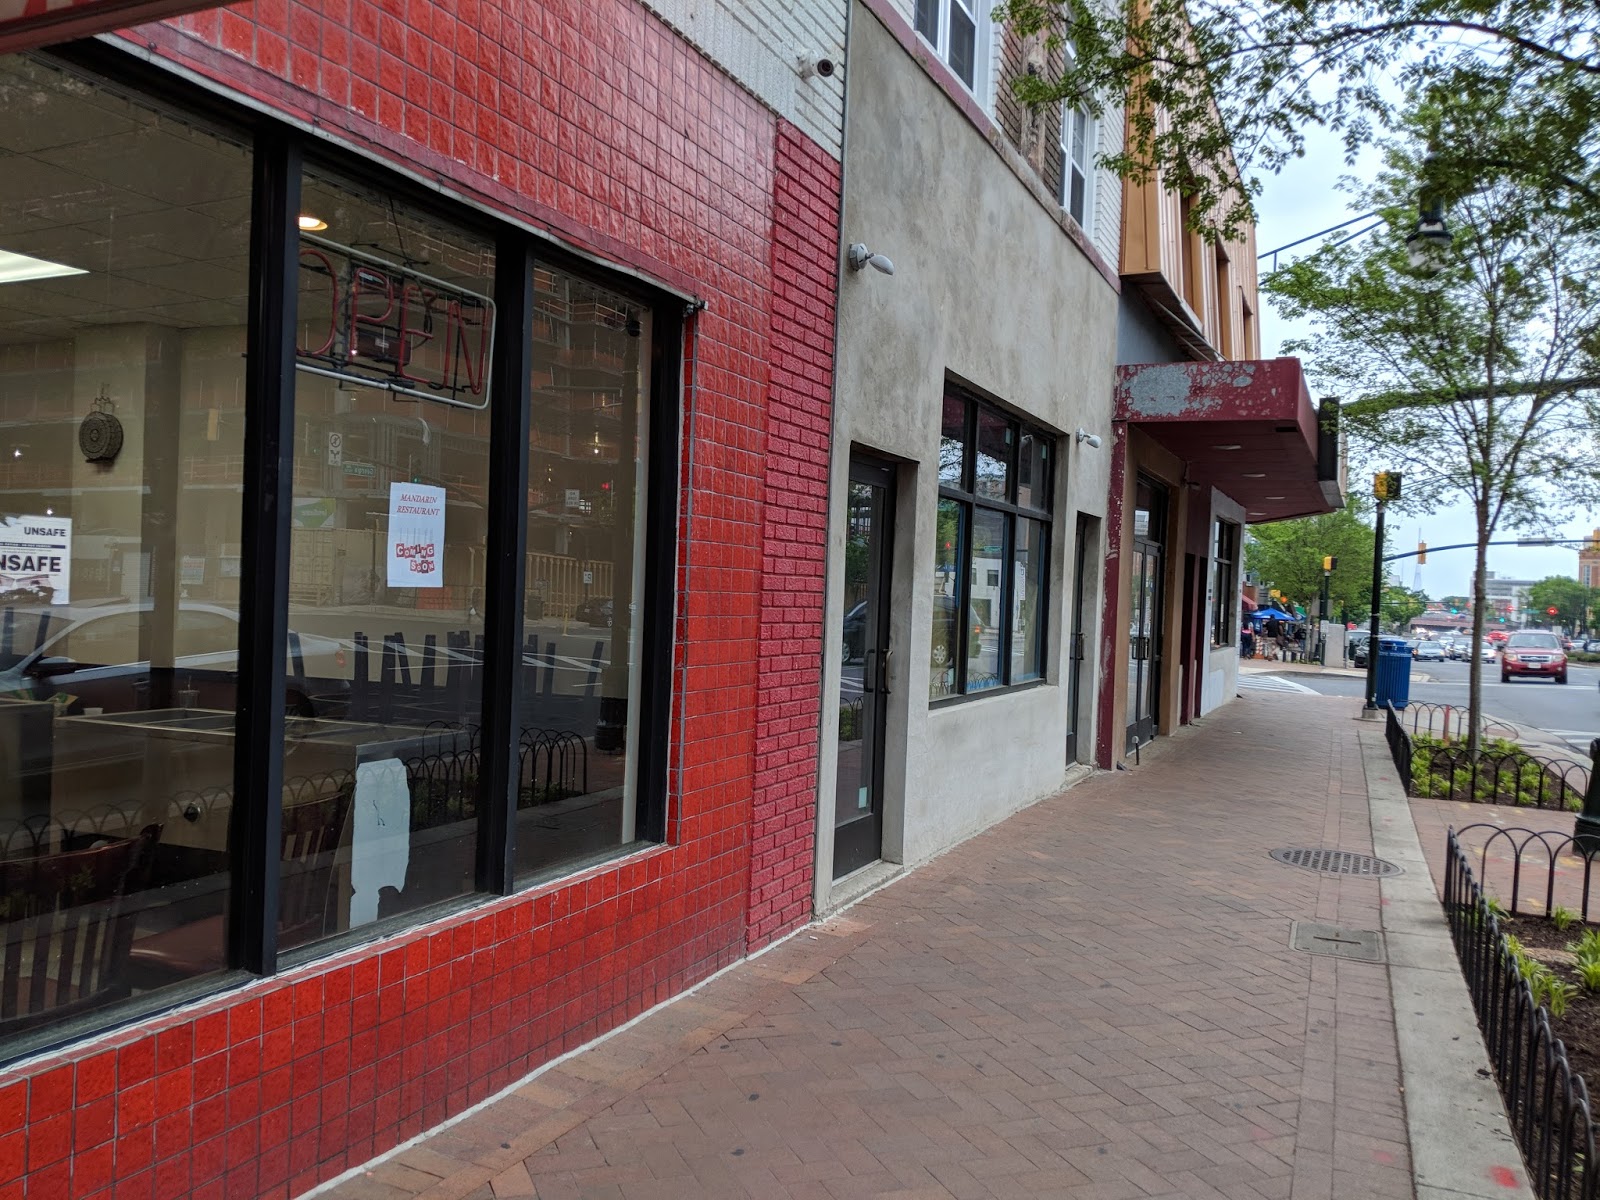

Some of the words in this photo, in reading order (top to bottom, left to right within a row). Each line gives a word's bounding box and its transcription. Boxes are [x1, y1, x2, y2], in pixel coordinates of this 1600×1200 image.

[297, 248, 488, 395] OPEN
[400, 493, 437, 504] MANDARIN
[396, 505, 440, 516] RESTAURANT
[24, 526, 66, 537] UNSAFE
[396, 544, 435, 559] COMING
[410, 560, 435, 573] SOON
